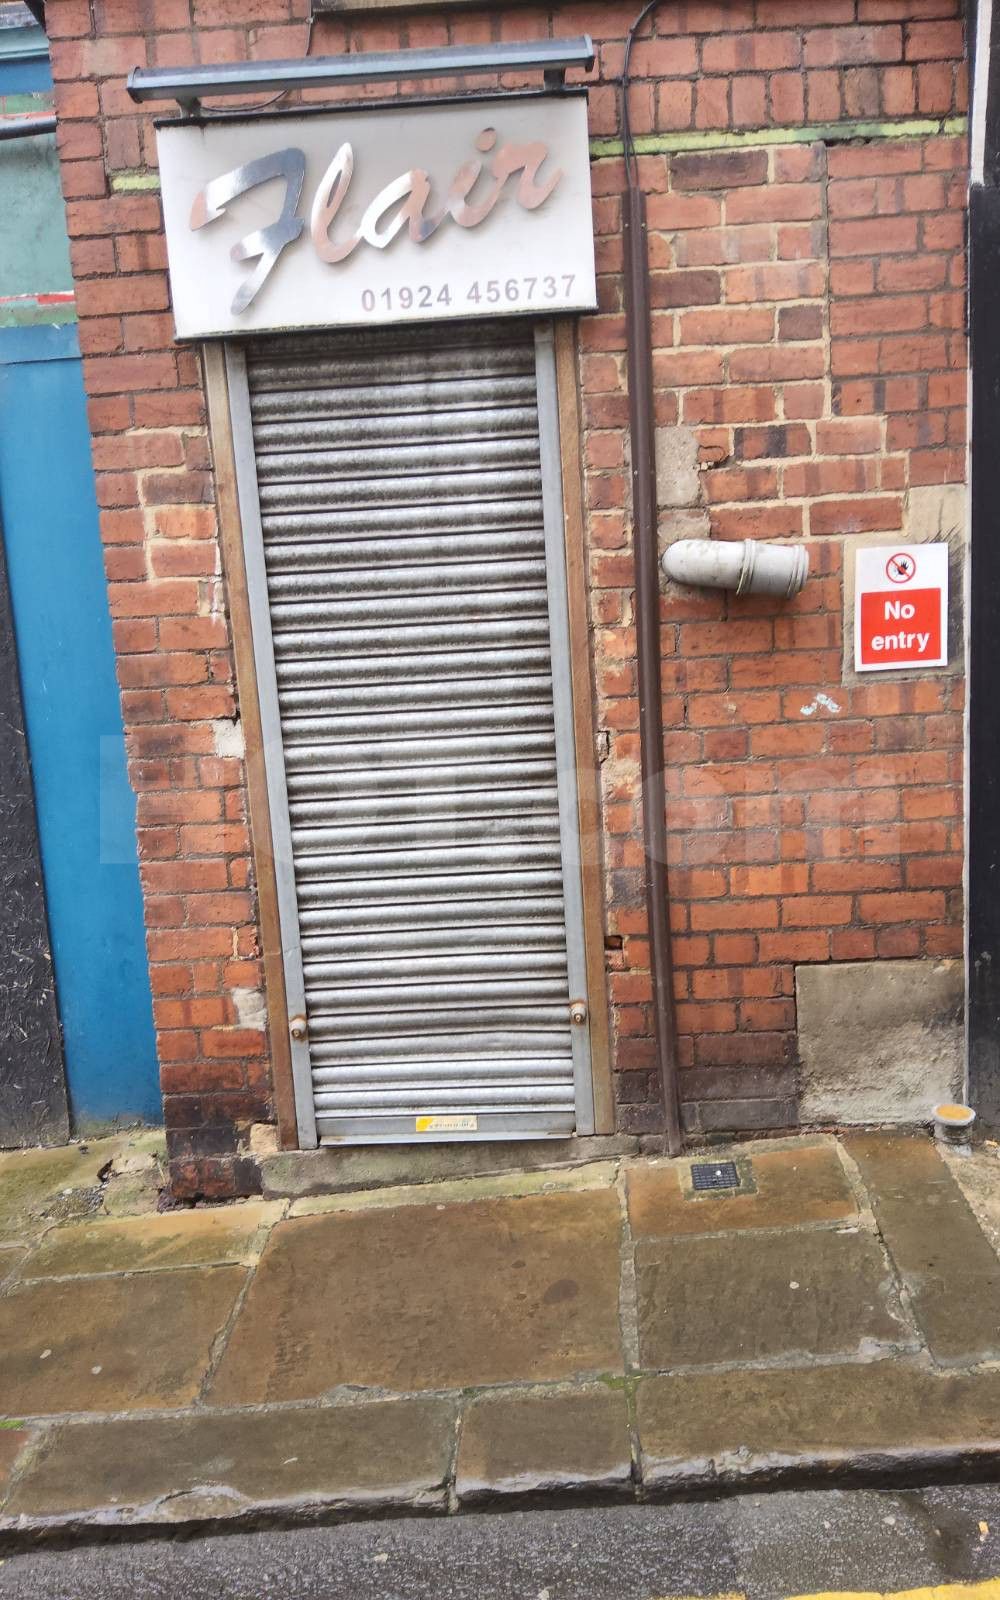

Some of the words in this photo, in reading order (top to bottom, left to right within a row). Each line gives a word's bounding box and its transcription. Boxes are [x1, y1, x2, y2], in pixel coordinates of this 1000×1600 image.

[190, 127, 564, 316] Flair
[361, 282, 453, 312] 01924
[466, 274, 576, 304] 456737
[884, 600, 916, 620] No
[871, 631, 930, 653] entry
